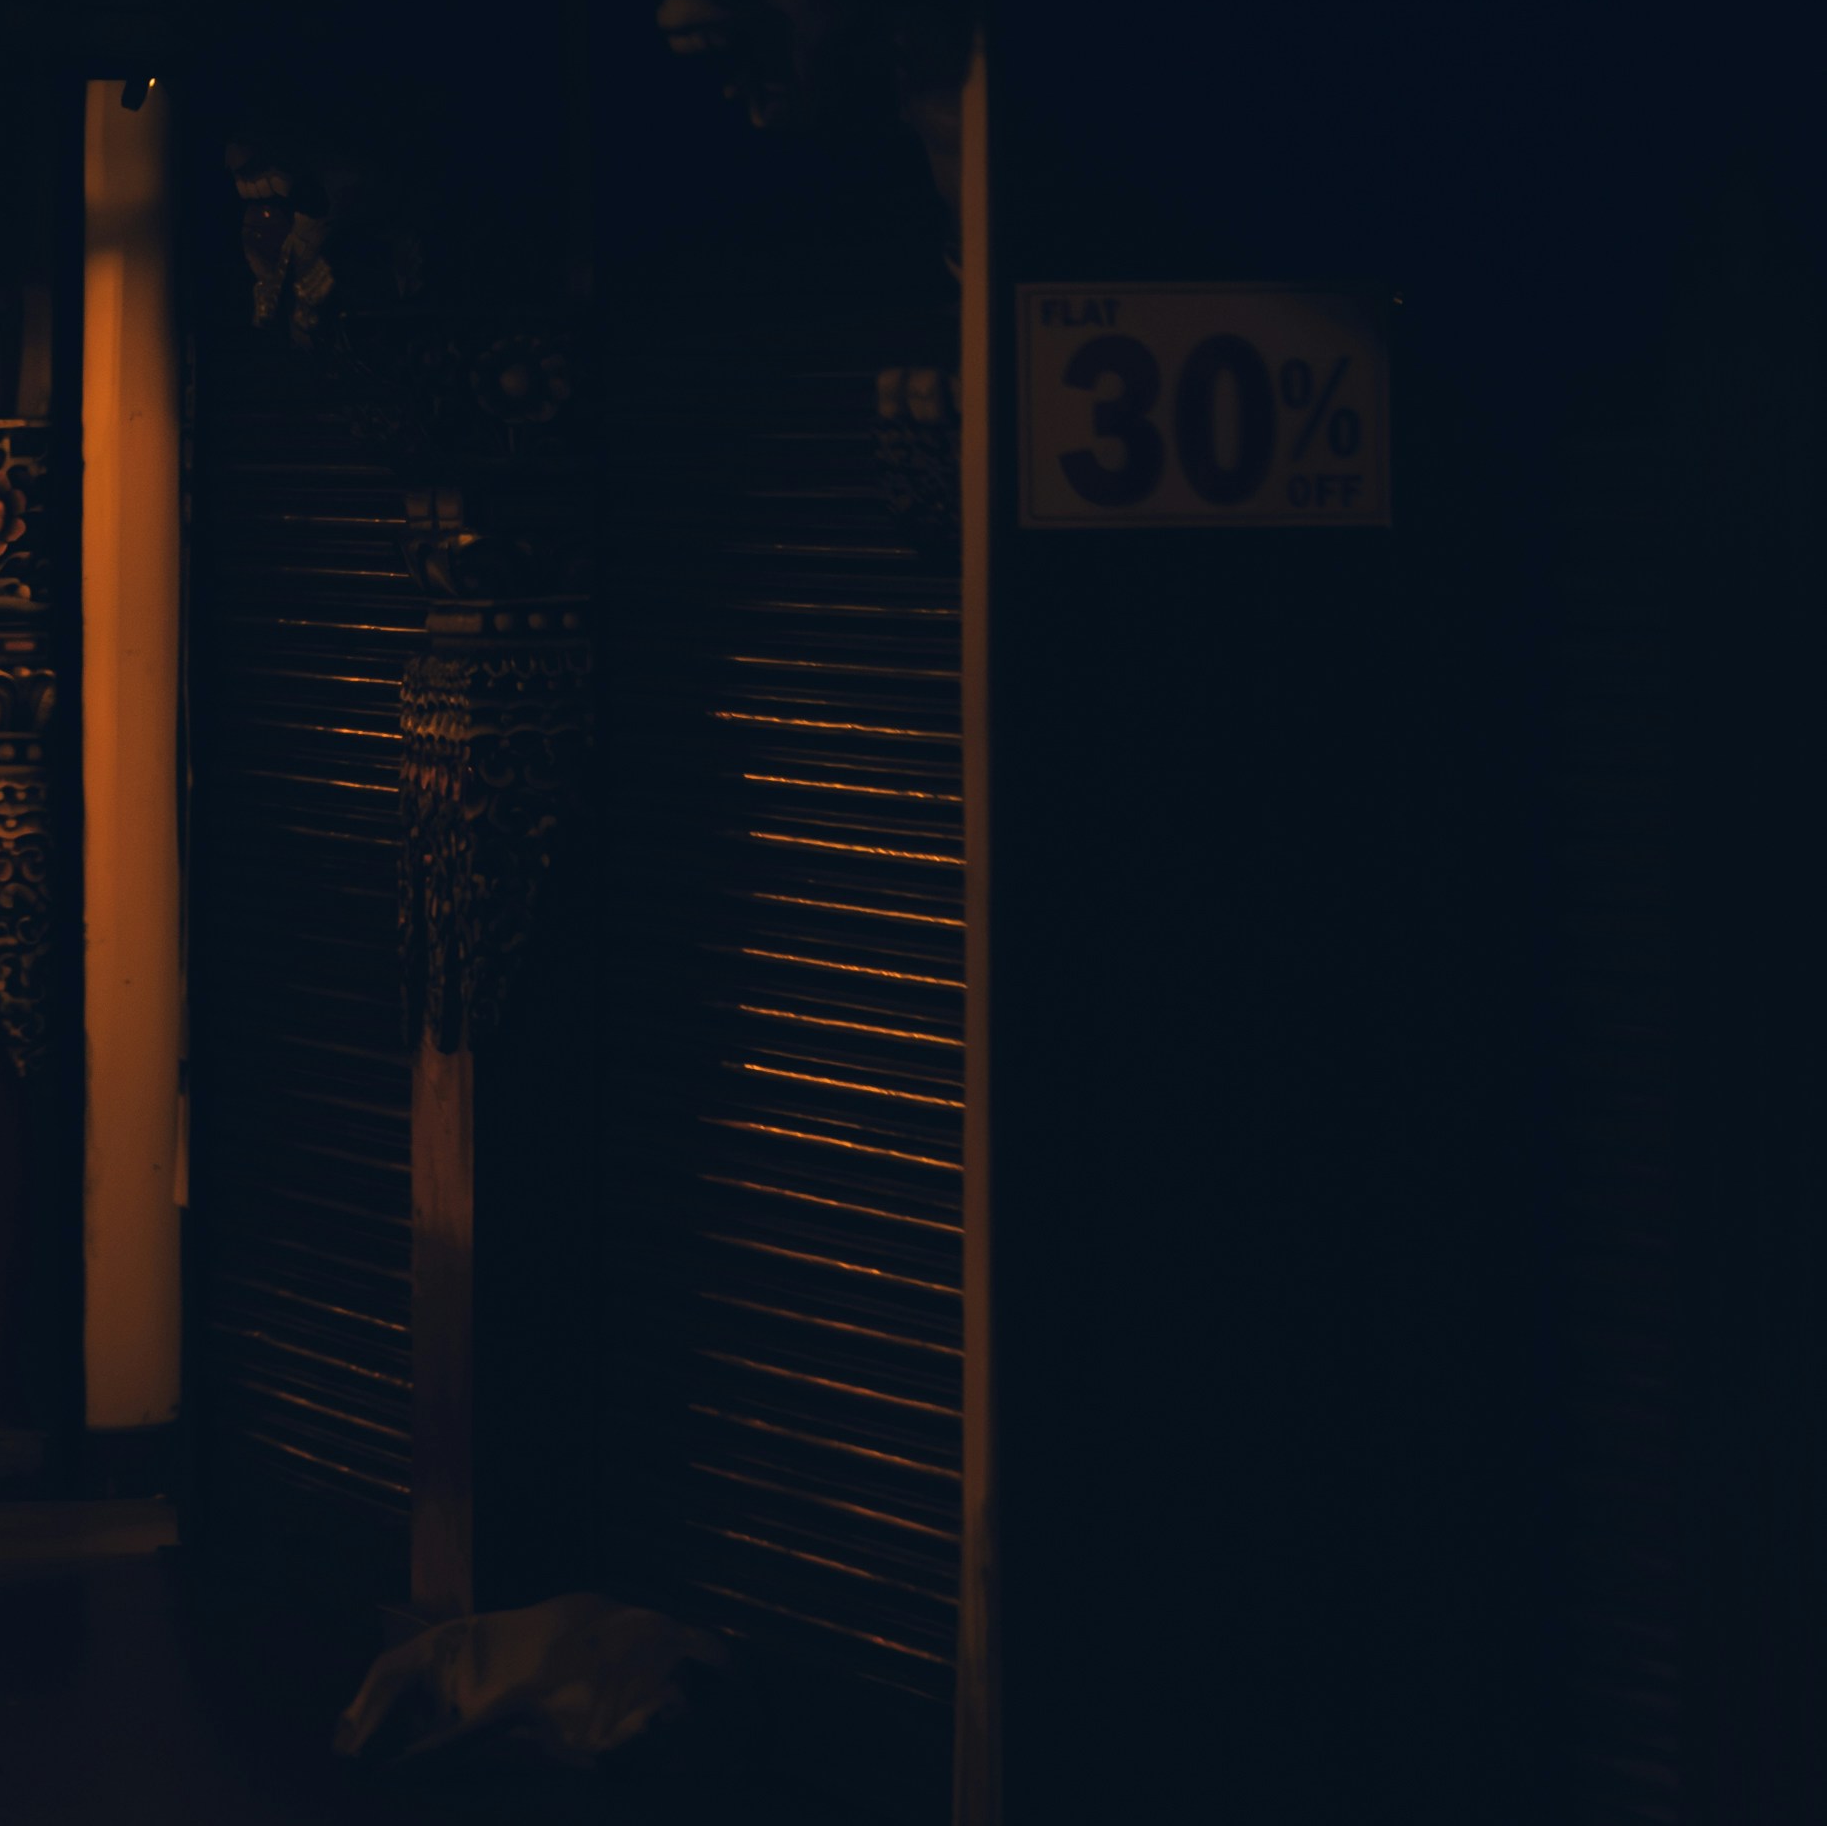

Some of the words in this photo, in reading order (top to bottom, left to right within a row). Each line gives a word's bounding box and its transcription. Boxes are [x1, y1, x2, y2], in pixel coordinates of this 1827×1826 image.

[1041, 298, 1122, 327] FLAT
[1058, 332, 1362, 508] 30%
[1286, 473, 1363, 509] OFF
